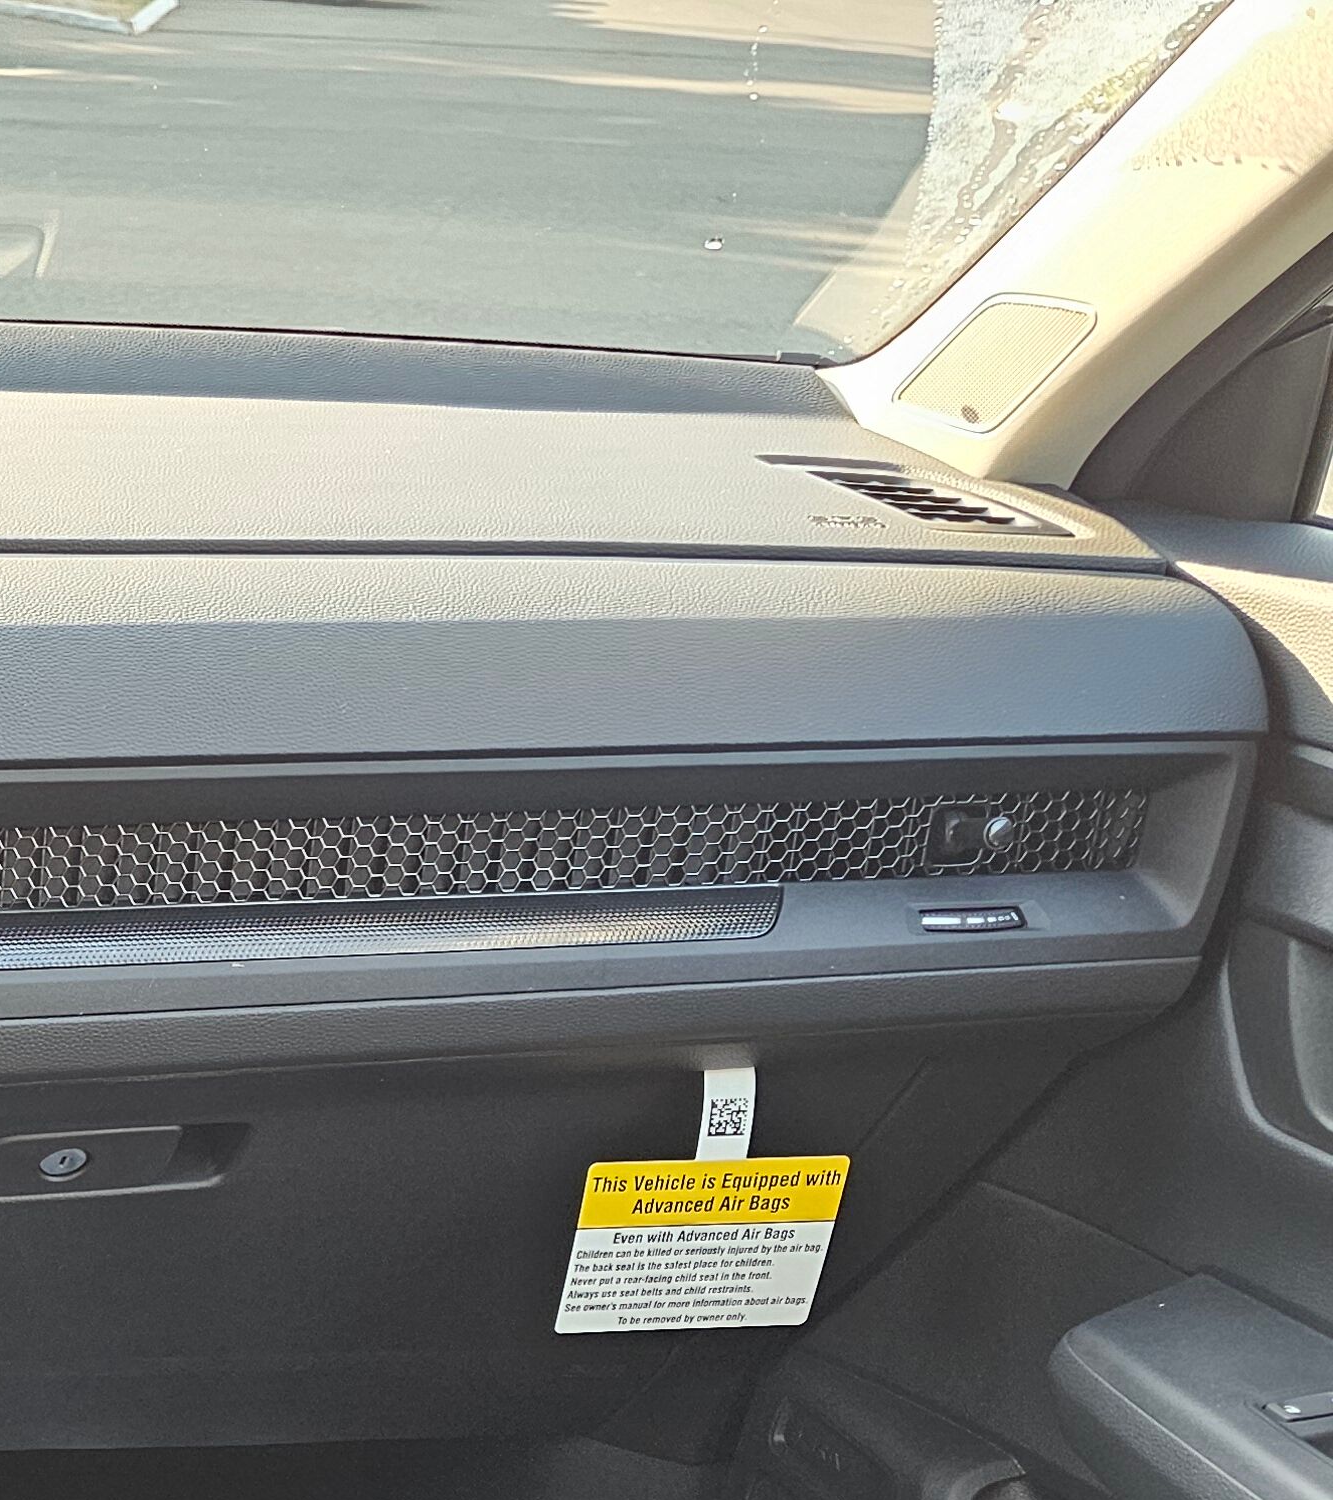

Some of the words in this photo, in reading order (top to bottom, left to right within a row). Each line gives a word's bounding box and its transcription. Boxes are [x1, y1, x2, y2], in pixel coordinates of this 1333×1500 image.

[593, 1176, 627, 1192] This
[635, 1174, 695, 1191] Vehicle
[702, 1174, 716, 1189] is
[722, 1171, 801, 1191] Equipped
[807, 1170, 841, 1186] with
[632, 1197, 714, 1214] Advanced
[719, 1196, 745, 1211] Air
[749, 1195, 790, 1213] Bags
[613, 1233, 643, 1244] Even
[647, 1231, 673, 1243] with
[677, 1229, 737, 1242] Advanced
[741, 1228, 761, 1240] Air
[764, 1227, 795, 1241] Bags
[576, 1250, 613, 1259] Children
[634, 1249, 644, 1257] be
[647, 1248, 671, 1256] killed
[685, 1246, 725, 1256] seriously
[727, 1245, 758, 1256] injured
[761, 1245, 772, 1255] by
[774, 1244, 787, 1252] the
[790, 1244, 802, 1252] air
[804, 1244, 823, 1253] bag.
[574, 1264, 589, 1272] The
[592, 1263, 613, 1272] back
[616, 1263, 635, 1271] seat
[637, 1262, 645, 1270] is
[648, 1262, 661, 1270] the
[664, 1261, 691, 1270] safest
[693, 1261, 718, 1269] place
[720, 1260, 733, 1268] for
[735, 1259, 774, 1267] children.
[570, 1278, 597, 1286] Never
[599, 1277, 613, 1286] put
[624, 1275, 672, 1284] rear-facing
[675, 1274, 697, 1282] child
[699, 1273, 718, 1281] seat
[732, 1272, 745, 1280] the
[748, 1271, 772, 1280] front.
[567, 1291, 598, 1300] Always
[602, 1290, 617, 1298] use
[619, 1289, 639, 1297] seat
[665, 1287, 682, 1295] and
[684, 1286, 706, 1295] child
[708, 1285, 753, 1294] restraints.
[565, 1304, 581, 1312] See
[583, 1303, 617, 1311] owner's
[619, 1301, 652, 1310] manual
[654, 1300, 666, 1309] for
[692, 1298, 742, 1307] information
[744, 1297, 769, 1305] about
[770, 1297, 783, 1305] air
[785, 1296, 808, 1306] bags.
[618, 1317, 627, 1325] To
[630, 1316, 641, 1324] be
[643, 1315, 682, 1324] removed
[684, 1315, 695, 1324] by
[697, 1314, 724, 1322] owner
[726, 1313, 747, 1322] only.
